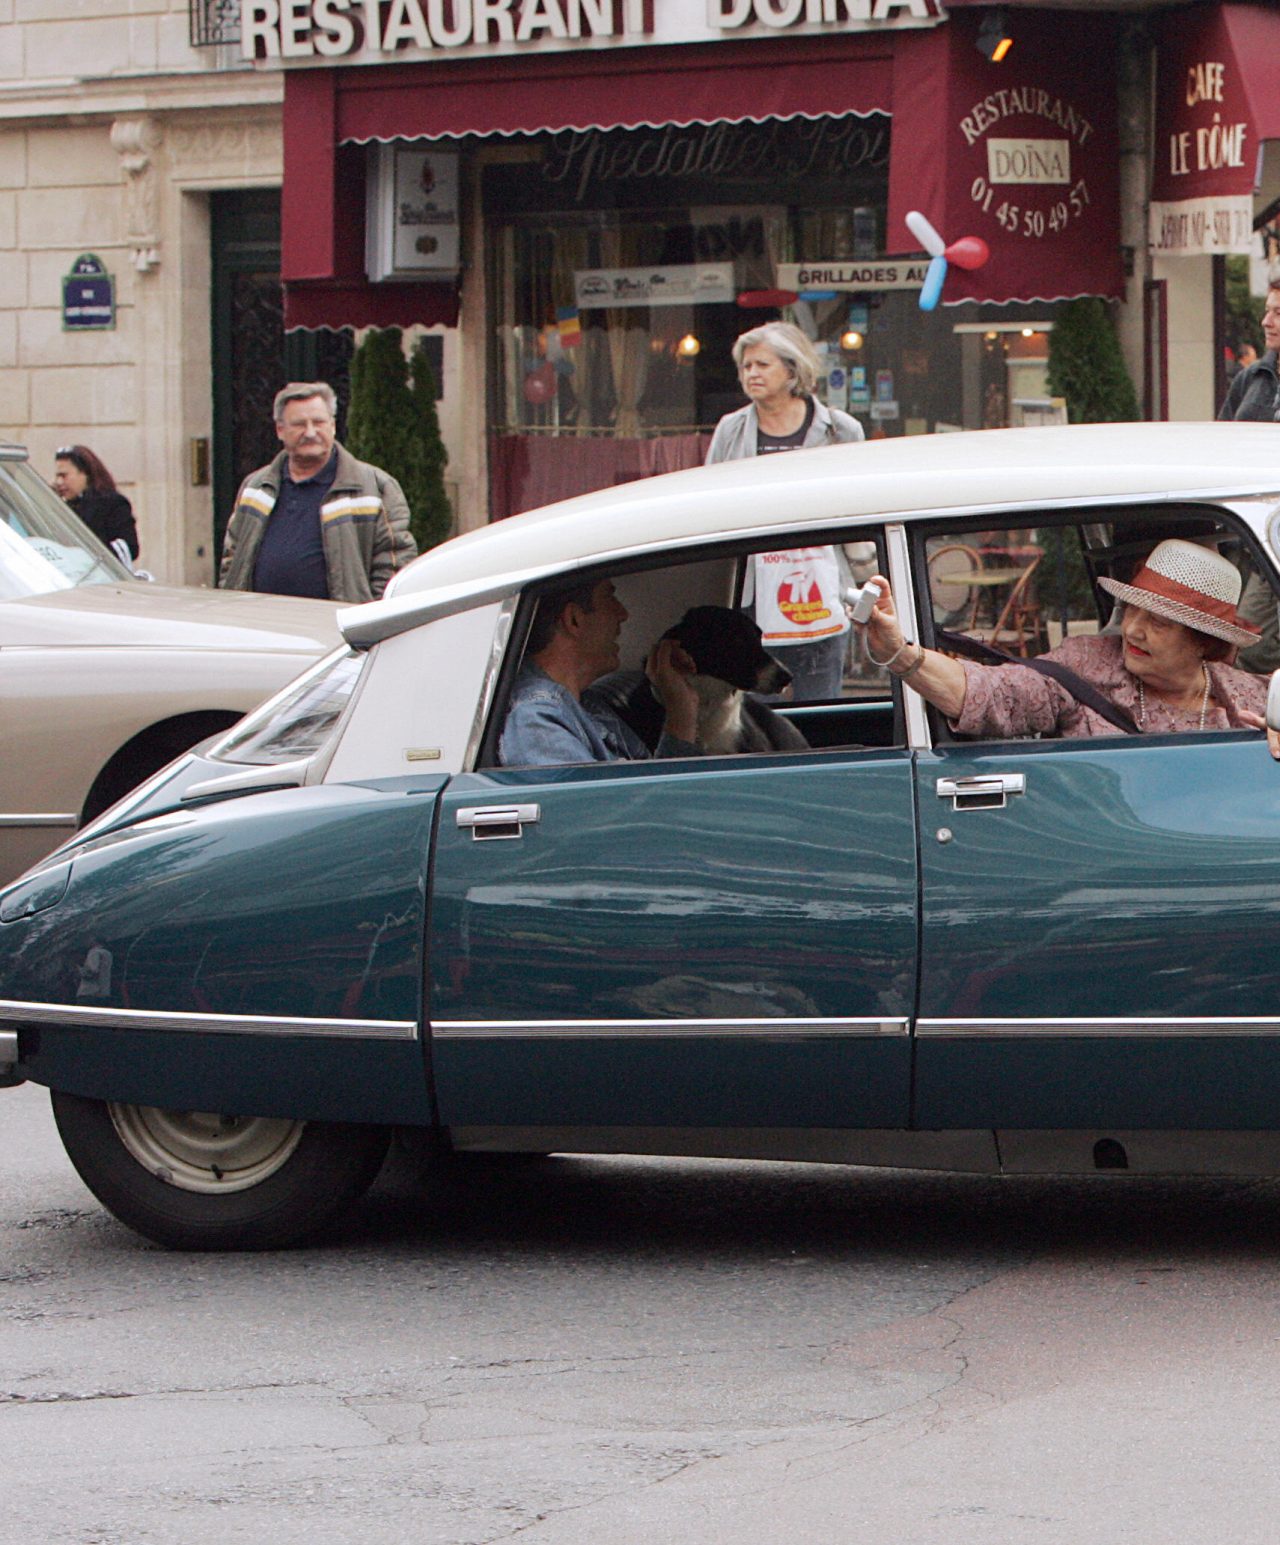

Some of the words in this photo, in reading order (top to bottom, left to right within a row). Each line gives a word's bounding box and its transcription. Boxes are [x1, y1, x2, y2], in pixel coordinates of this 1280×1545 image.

[959, 86, 1094, 146] RESTAURANT
[1170, 131, 1190, 175] LE
[1196, 112, 1247, 171] DÔME
[970, 177, 994, 212] 01
[996, 202, 1019, 232] 45
[1023, 210, 1045, 237] 50
[1049, 202, 1068, 232] 49
[1069, 178, 1090, 217] 57
[797, 268, 898, 285] GRILLADES
[761, 554, 791, 564] 100%
